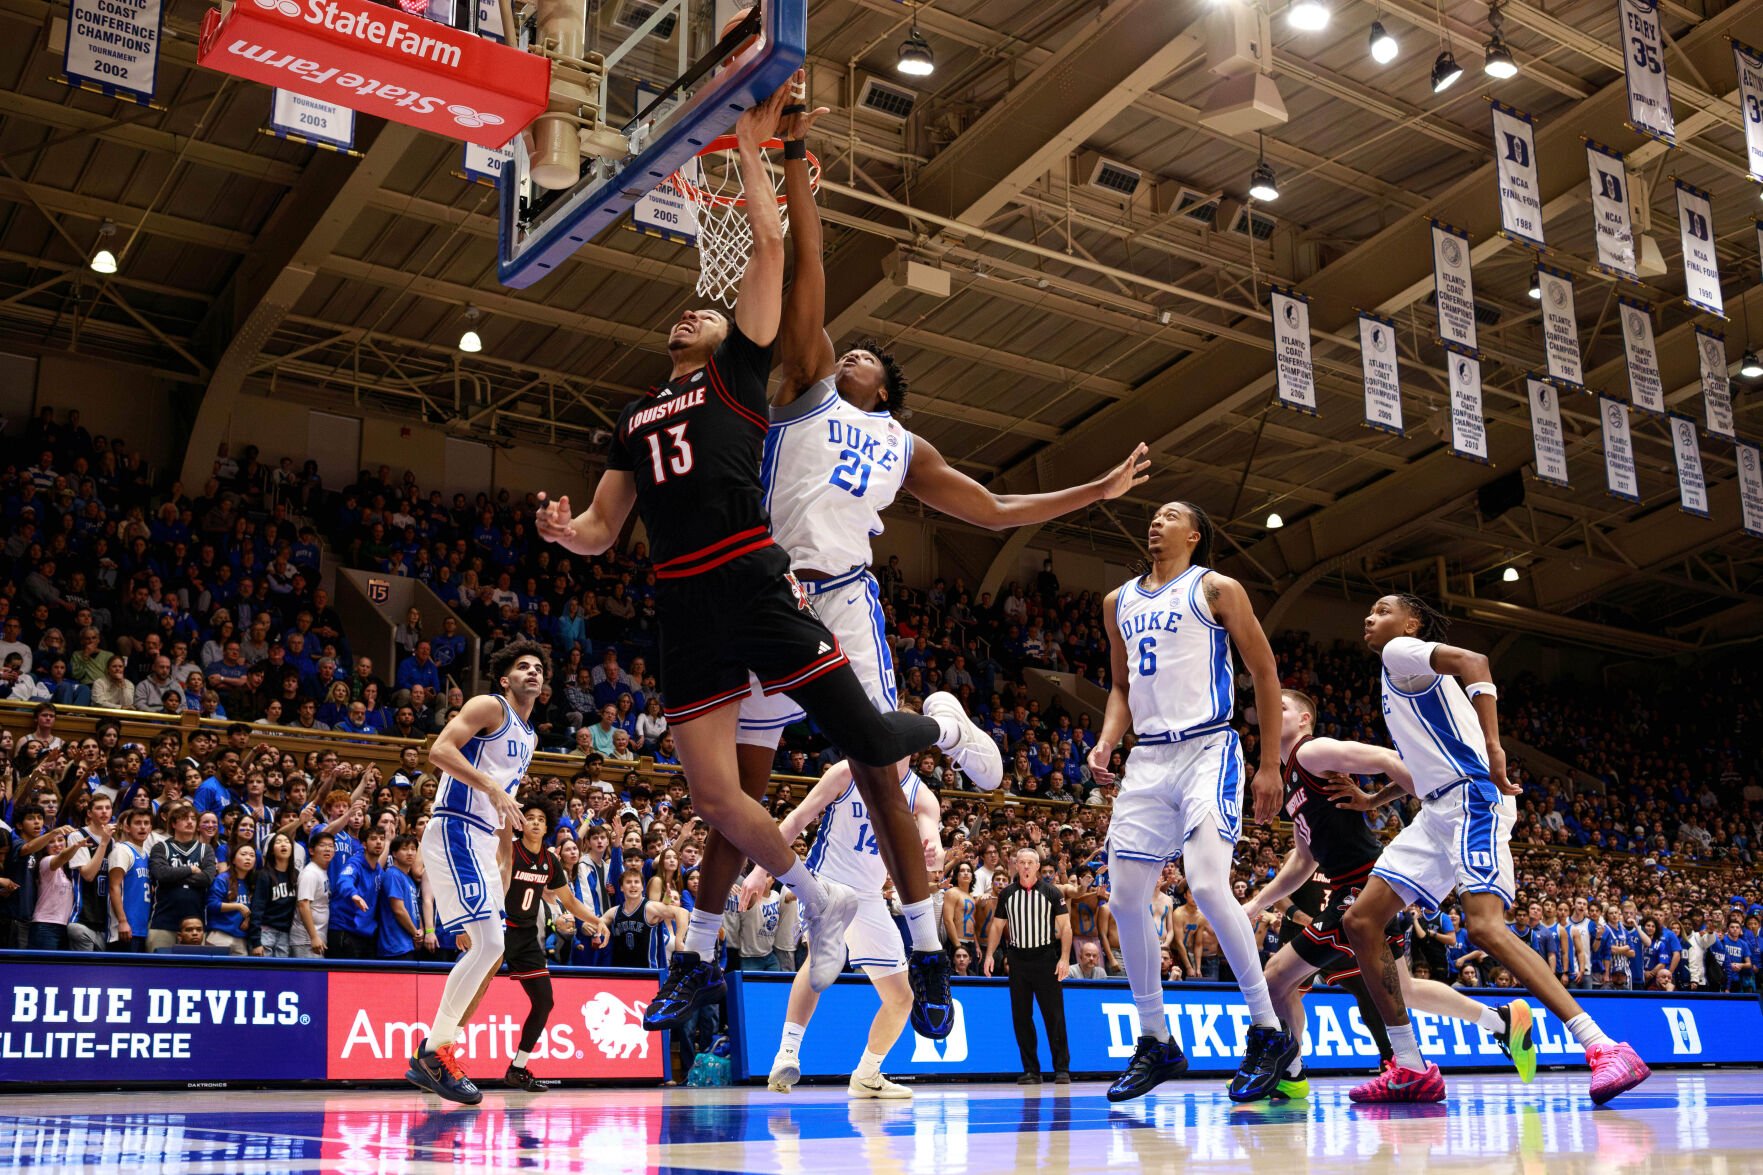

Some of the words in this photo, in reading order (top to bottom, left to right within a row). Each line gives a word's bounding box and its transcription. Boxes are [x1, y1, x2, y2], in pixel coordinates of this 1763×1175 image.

[97, 0, 138, 20] COAST
[75, 8, 156, 41] CONFERENCE
[77, 24, 151, 54] CHAMPIONS
[88, 44, 137, 63] TOURNAMENT
[1632, 37, 1661, 74] 35
[94, 59, 129, 79] 2002
[293, 97, 337, 115] TOURNAMENT
[300, 113, 327, 129] 2003
[1511, 175, 1529, 190] NCAA
[649, 195, 684, 210] TOURNAMENT
[1502, 188, 1521, 203] FINAL
[1523, 195, 1539, 209] FOUR
[653, 209, 679, 224] 2005
[1516, 217, 1533, 232] 1988
[1605, 211, 1622, 225] NCAA
[1693, 248, 1708, 262] NCAA
[1687, 260, 1702, 274] FINAL
[1443, 272, 1466, 288] ATLANTIC
[1447, 284, 1464, 296] COAST
[1439, 291, 1473, 311] CONFERENCE
[1441, 302, 1473, 320] CHAMPIONS
[1548, 313, 1572, 328] ATLANTIC
[1281, 335, 1306, 350] ATLANTIC
[1286, 347, 1303, 358] COAST
[1278, 354, 1312, 371] CONFERENCE
[1368, 359, 1393, 372] ATLANTIC
[1280, 364, 1312, 380] CHAMPIONS
[1374, 369, 1390, 381] COAST
[1365, 376, 1399, 393] CONFERENCE
[1456, 390, 1478, 405] ATLANTIC
[627, 386, 707, 435] LOUISVILLE
[645, 420, 695, 485] 13
[827, 419, 899, 472] DUKE
[828, 449, 872, 498] 21
[372, 586, 387, 601] 15
[1121, 610, 1184, 642] DUKE
[1138, 636, 1157, 677] 6
[853, 823, 879, 855] 14
[522, 887, 534, 912] 0
[11, 986, 133, 1024] BLUE
